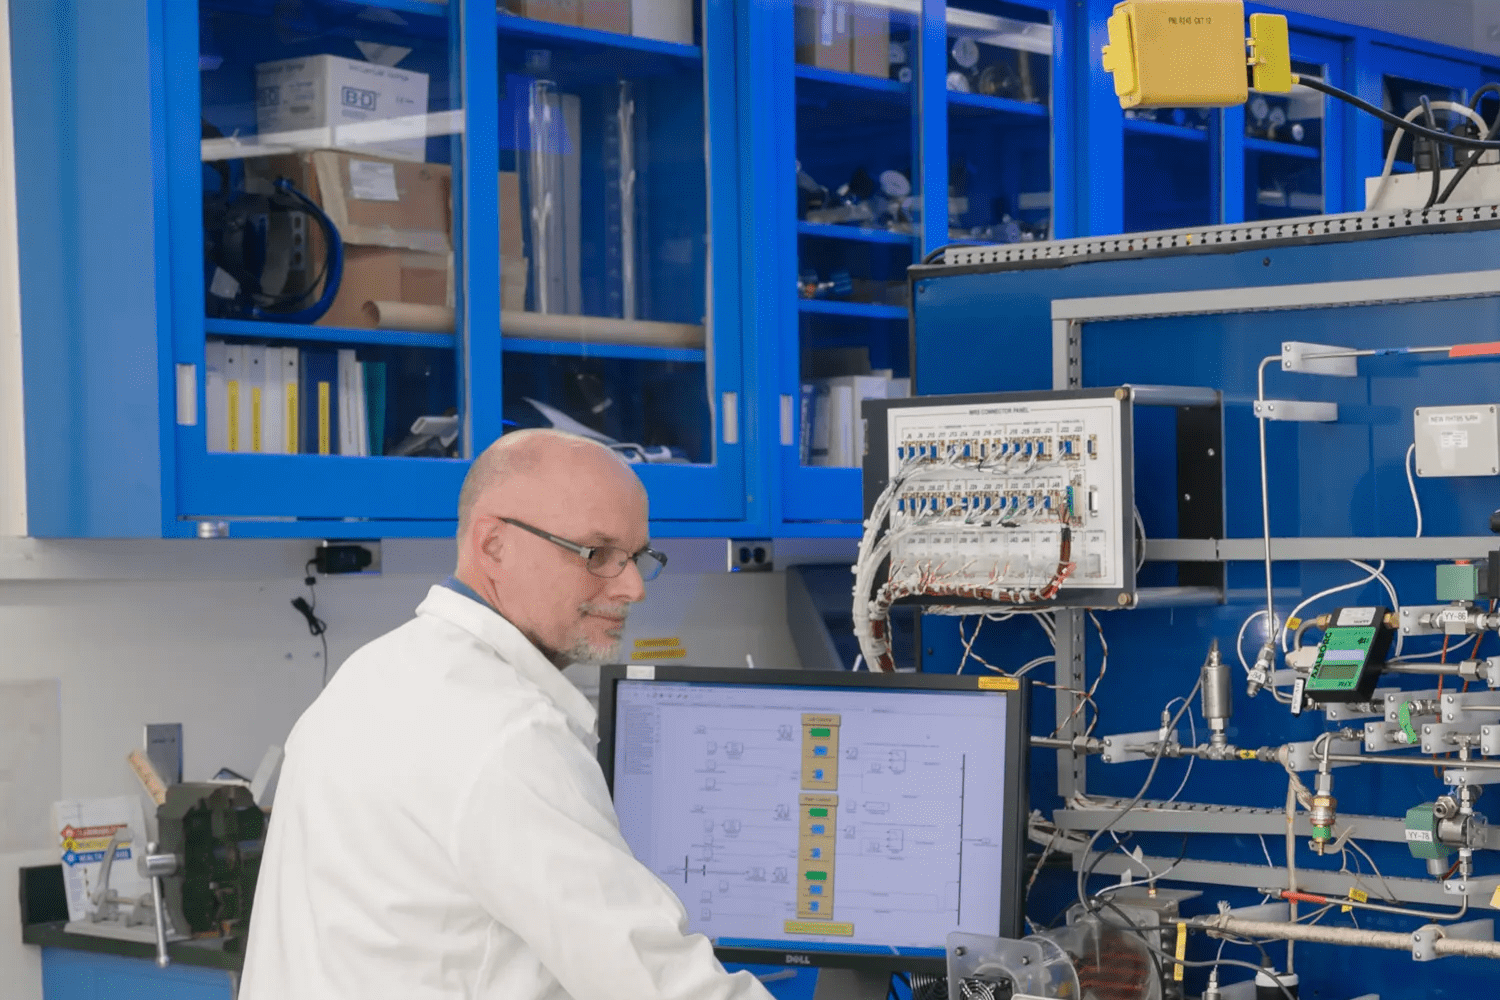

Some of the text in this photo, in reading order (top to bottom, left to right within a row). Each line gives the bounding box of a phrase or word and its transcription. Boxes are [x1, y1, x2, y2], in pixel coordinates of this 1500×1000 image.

[1444, 612, 1466, 620] YY-86
[1311, 632, 1333, 680] AALBORG
[1408, 832, 1430, 840] YY-78
[786, 954, 810, 964] DELL
